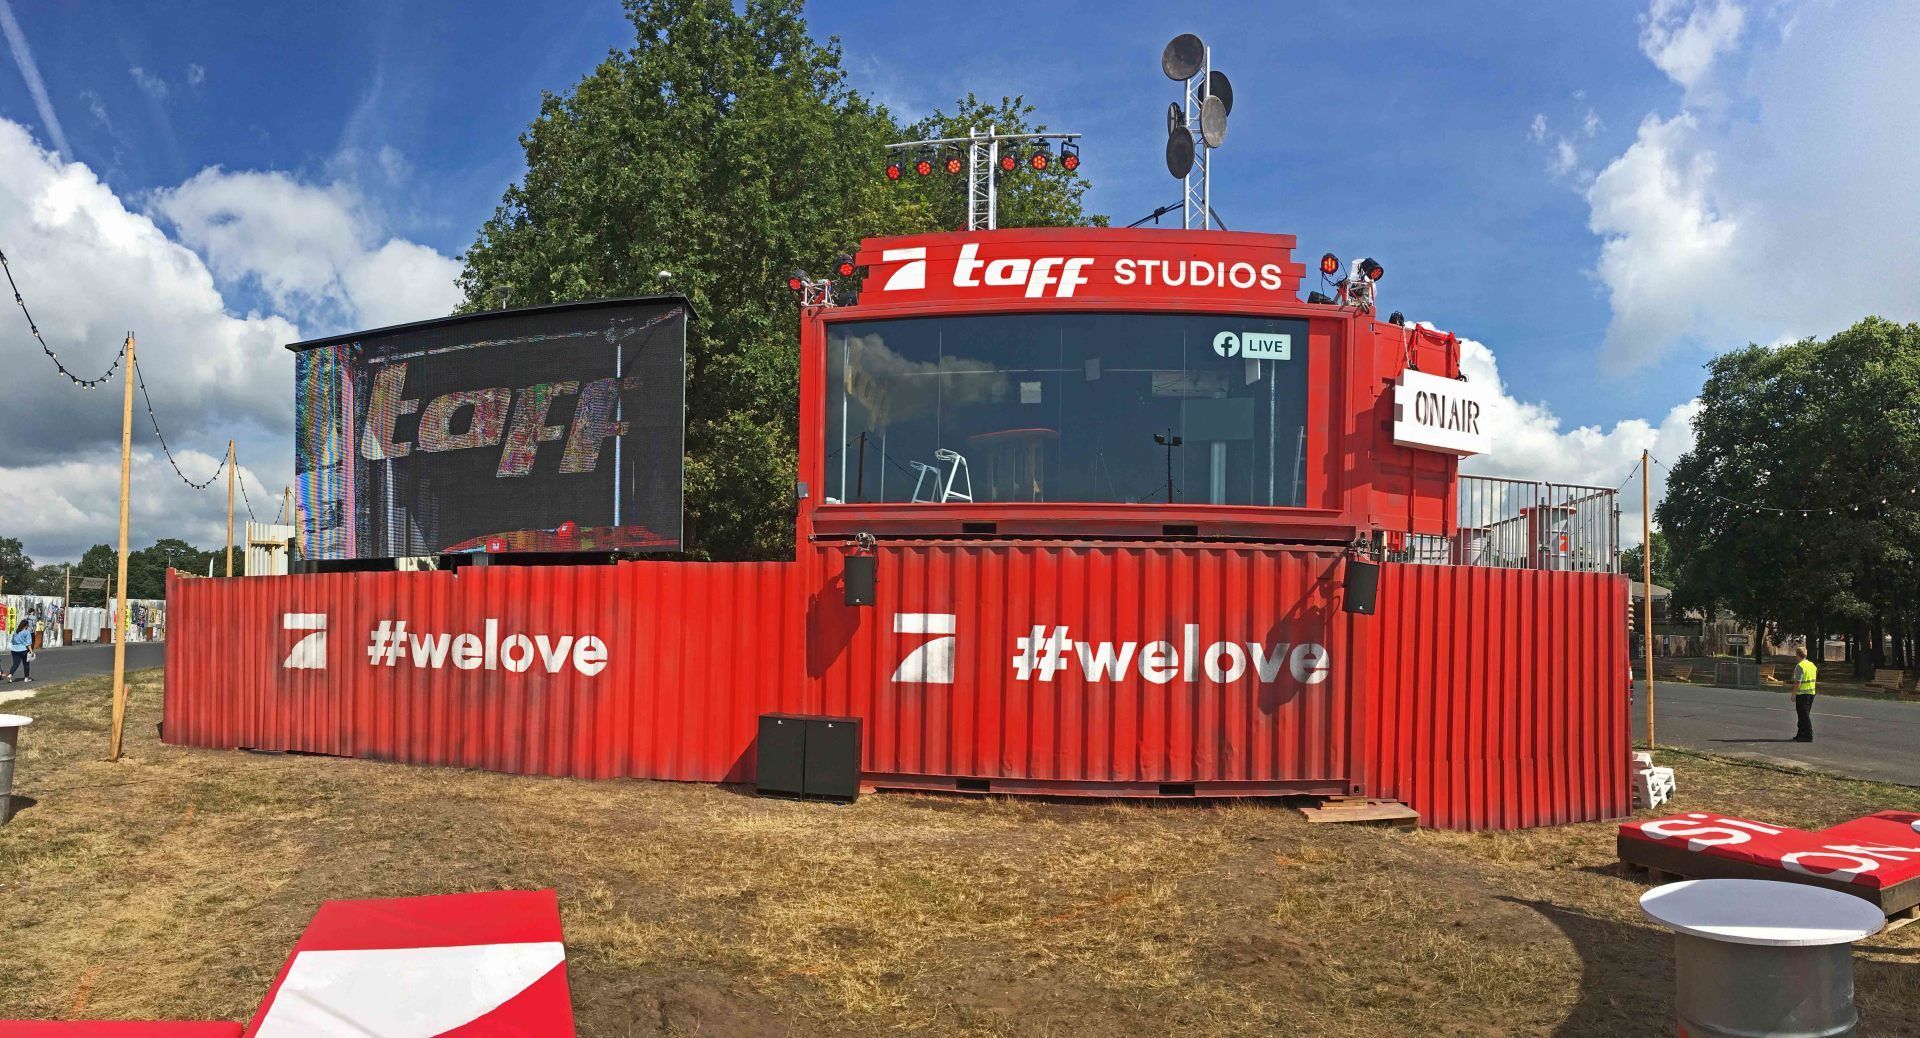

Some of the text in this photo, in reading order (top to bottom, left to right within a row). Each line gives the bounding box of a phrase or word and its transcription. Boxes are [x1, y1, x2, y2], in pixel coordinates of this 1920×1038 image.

[952, 243, 1095, 298] taff
[1113, 258, 1282, 290] STUDIOS
[1249, 341, 1283, 353] LIVE
[361, 362, 643, 478] taff
[1415, 390, 1480, 435] ON AIR
[367, 618, 608, 677] #welove
[1012, 623, 1330, 685] #welove
